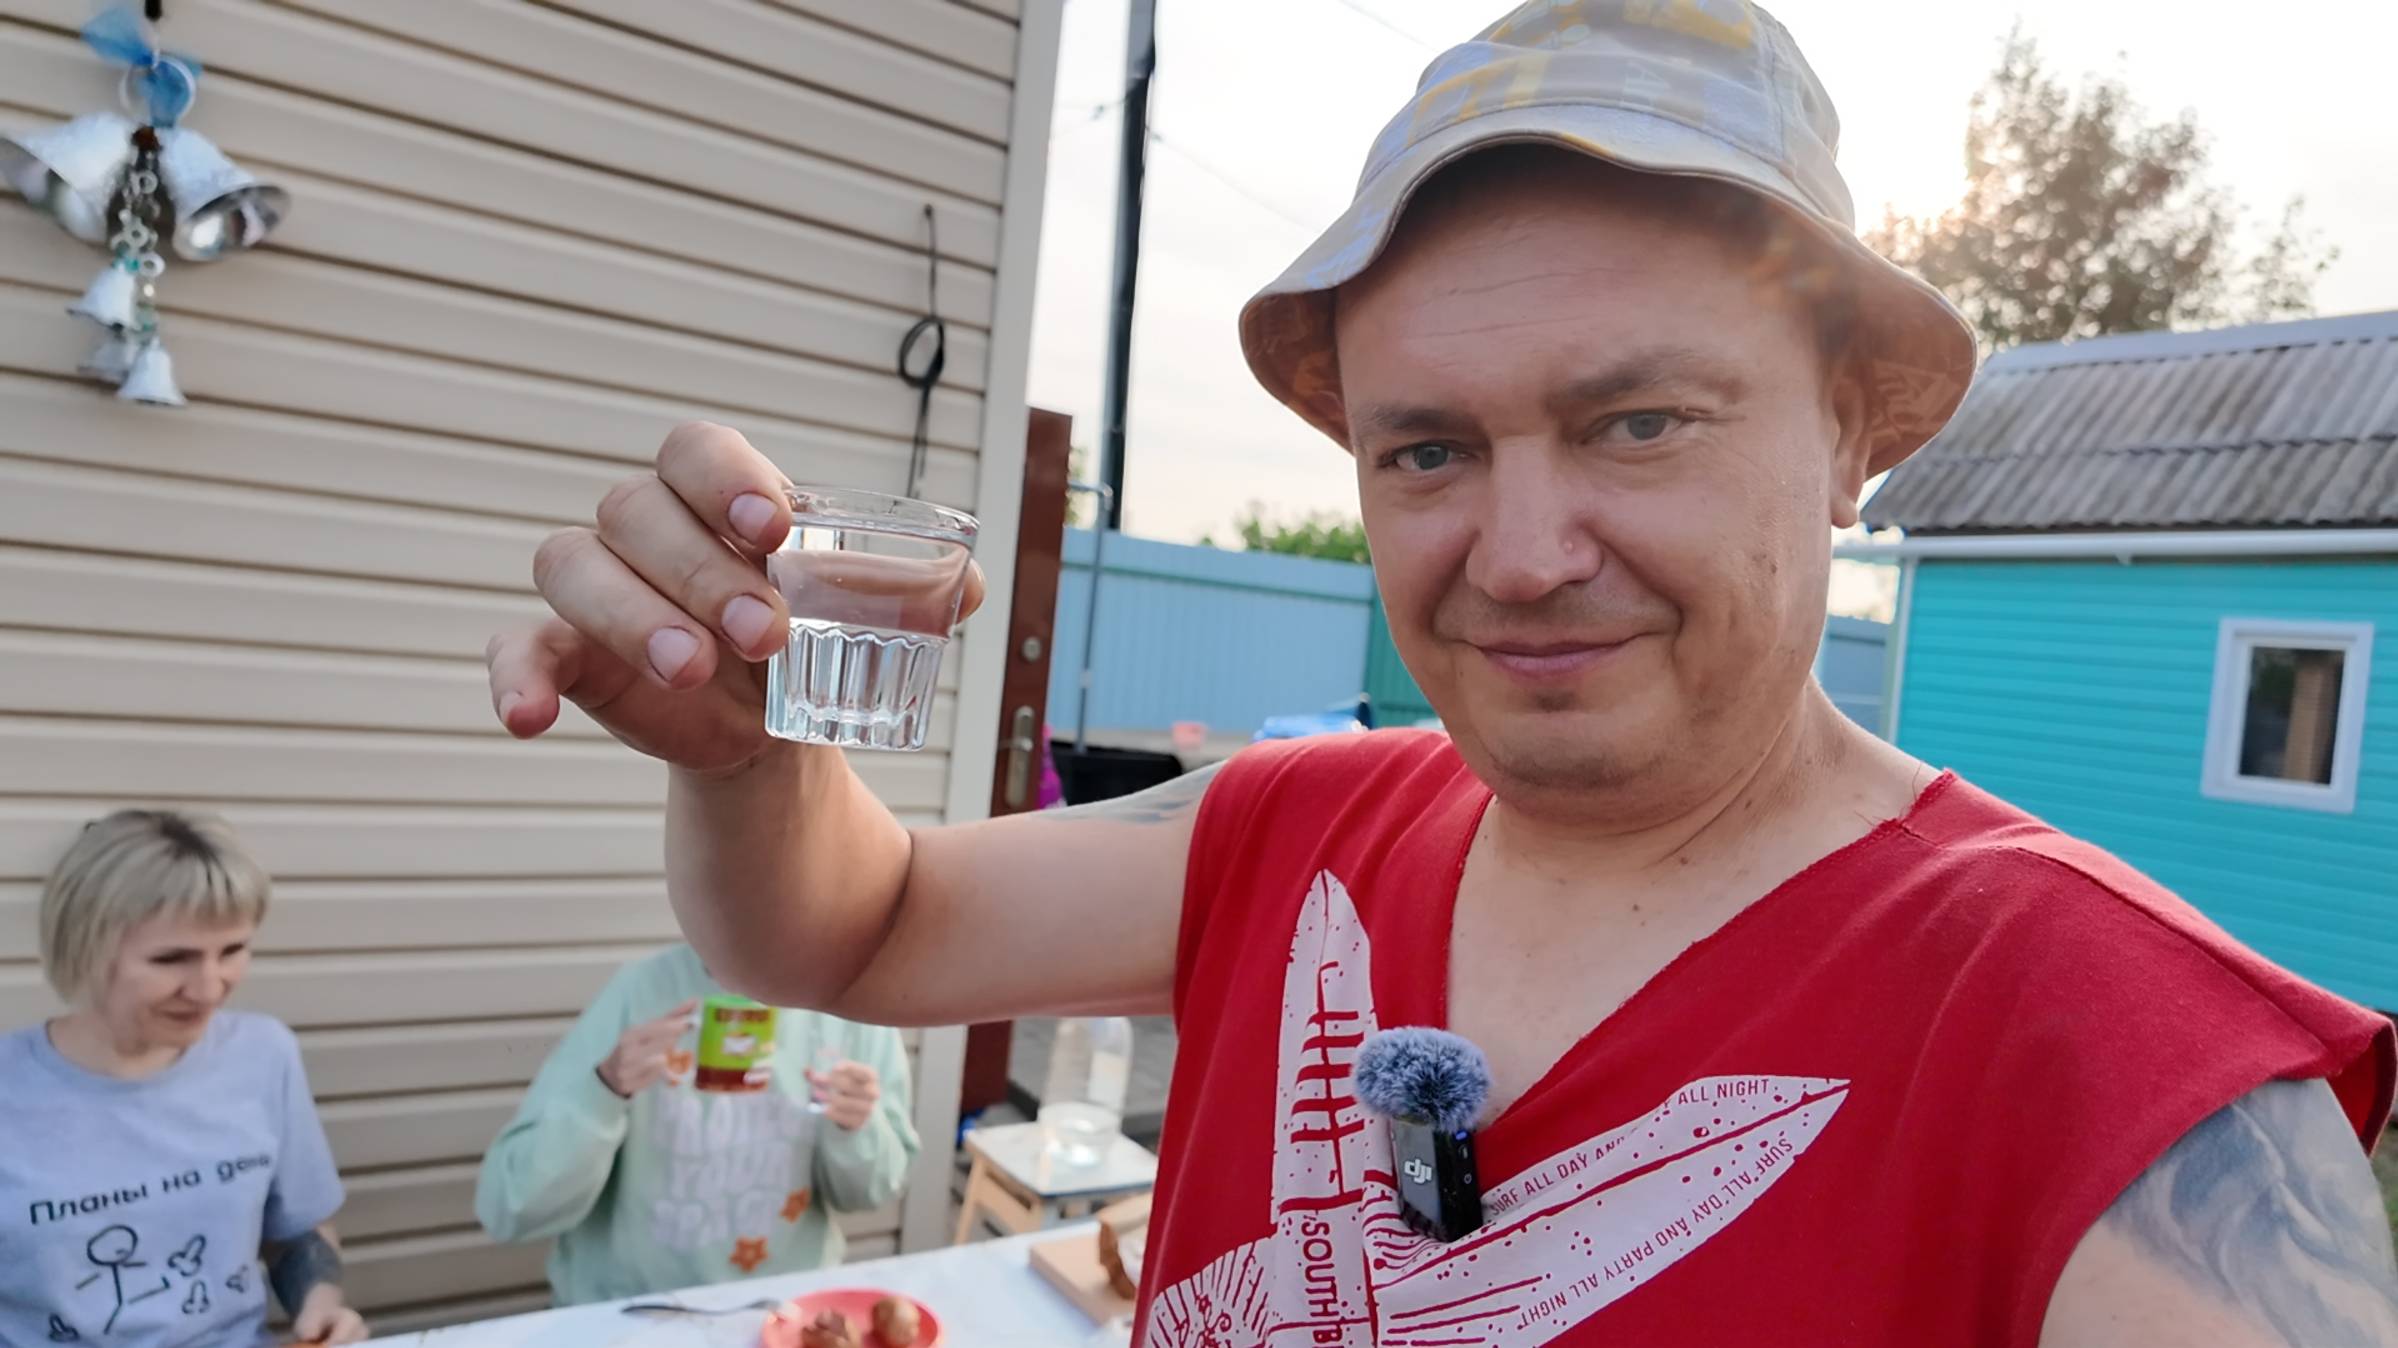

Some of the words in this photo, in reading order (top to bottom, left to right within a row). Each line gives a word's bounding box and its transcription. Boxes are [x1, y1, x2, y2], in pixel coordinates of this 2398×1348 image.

[1678, 1086, 1709, 1105] ALL
[1717, 1078, 1769, 1099] NIGHT
[1755, 1138, 1793, 1175] SURF
[29, 1184, 148, 1225] Планы
[162, 1170, 201, 1193] на
[1489, 1187, 1520, 1216] SURF
[1524, 1172, 1554, 1196] ALL
[1556, 1153, 1588, 1179] DAY
[1721, 1171, 1752, 1197] ALL
[1692, 1194, 1723, 1223] DAY
[1655, 1217, 1688, 1247] AND
[1604, 1240, 1655, 1281] PARTY
[1569, 1273, 1599, 1299] ALL
[1521, 1291, 1568, 1328] NIGHT
